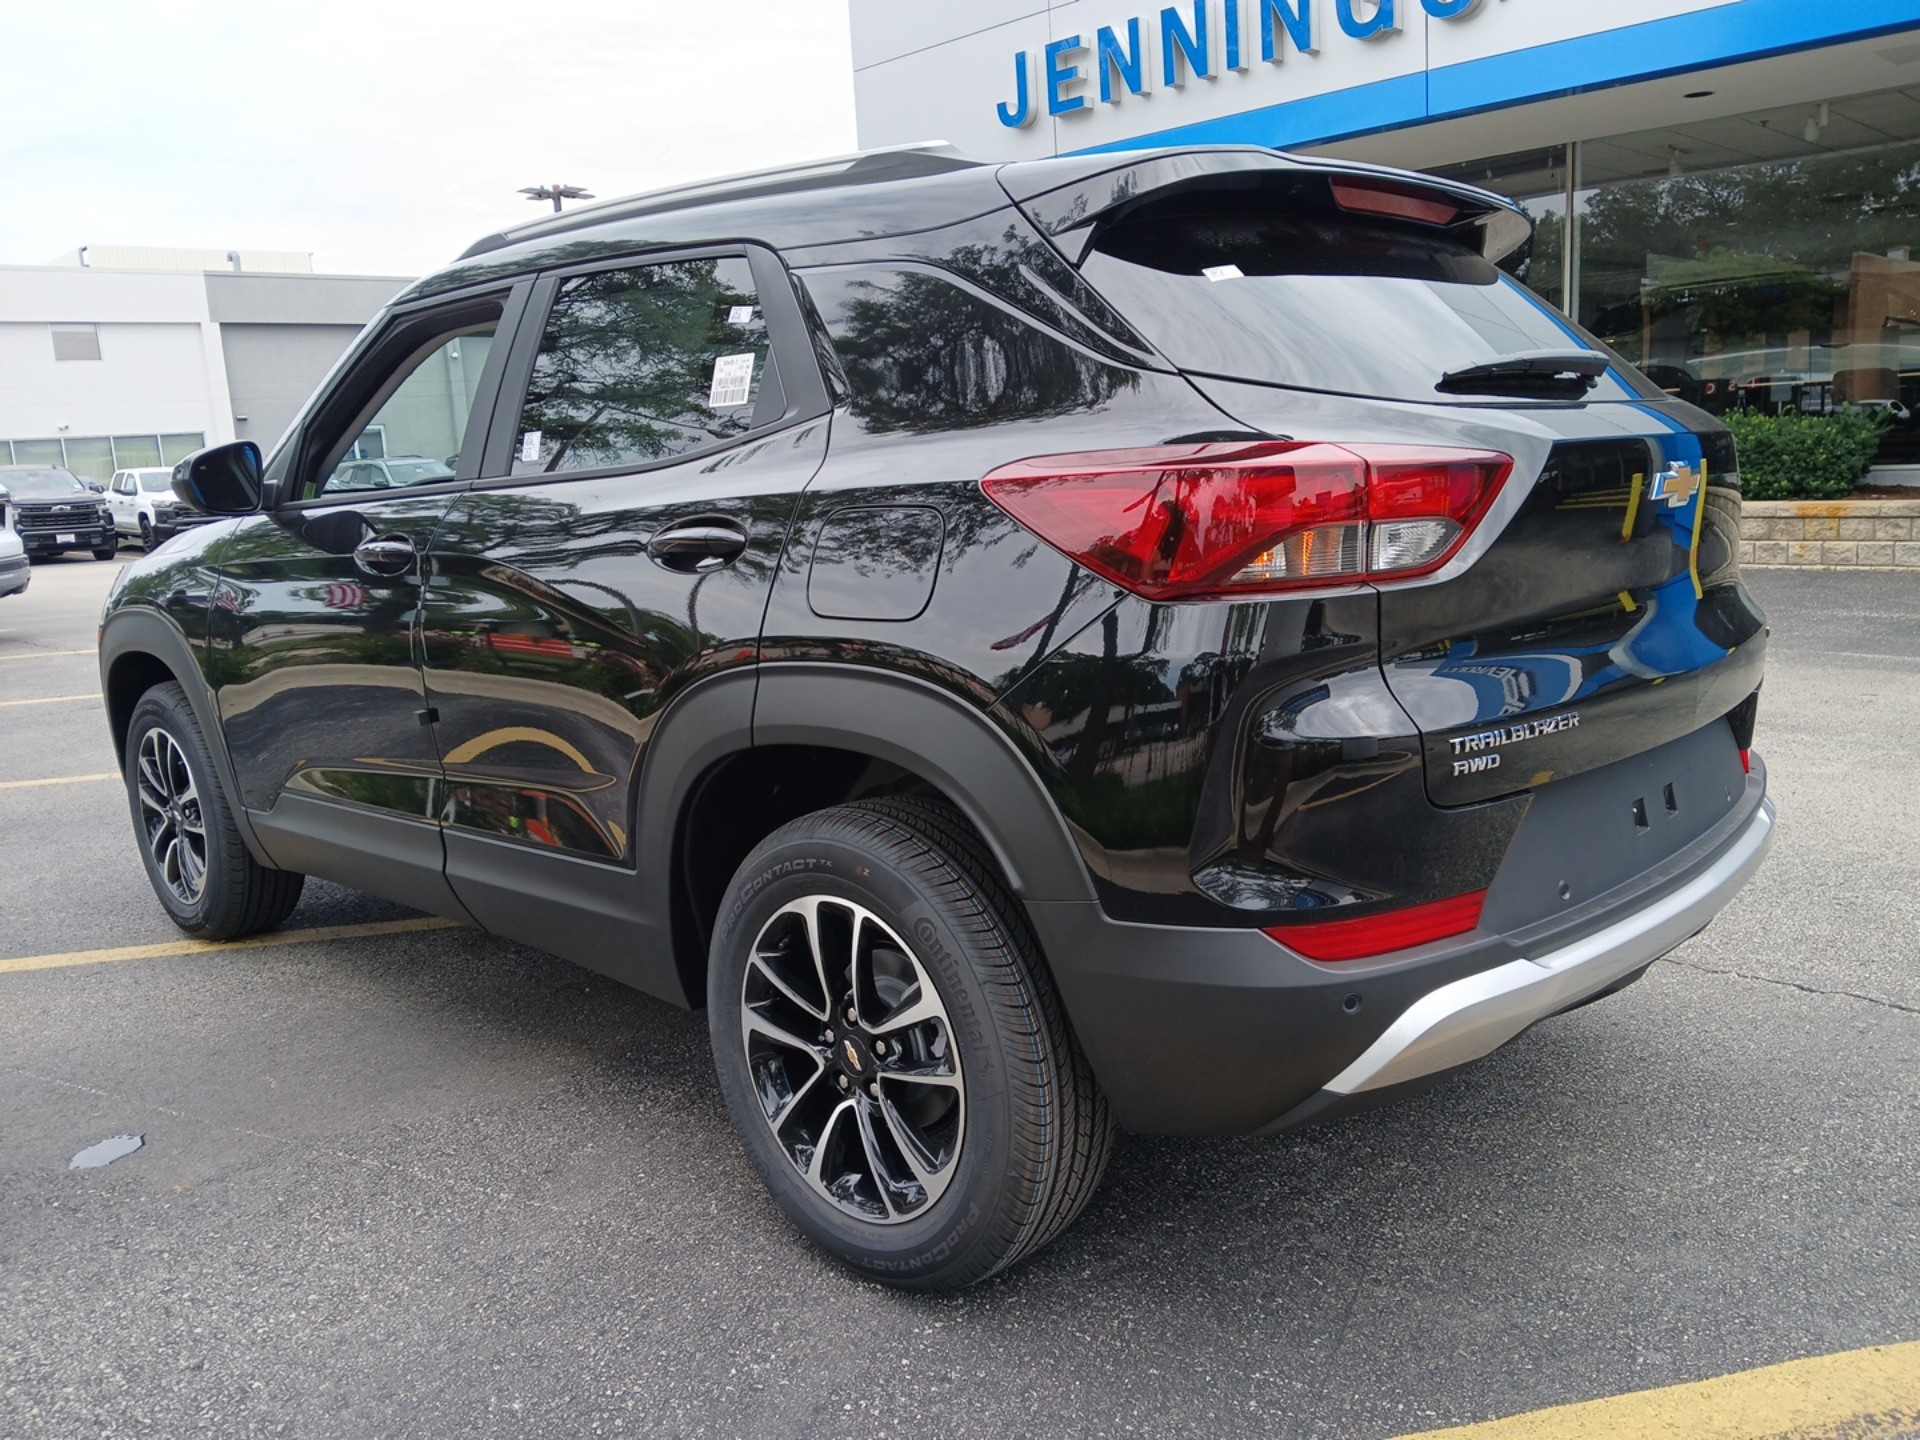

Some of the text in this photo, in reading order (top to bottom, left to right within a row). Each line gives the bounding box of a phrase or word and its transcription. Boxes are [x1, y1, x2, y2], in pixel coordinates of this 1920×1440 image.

[996, 0, 1480, 128] JENNIN
[1449, 711, 1580, 754] TRAILBLAZER
[1453, 753, 1501, 777] AWD
[913, 916, 992, 1051] Continental
